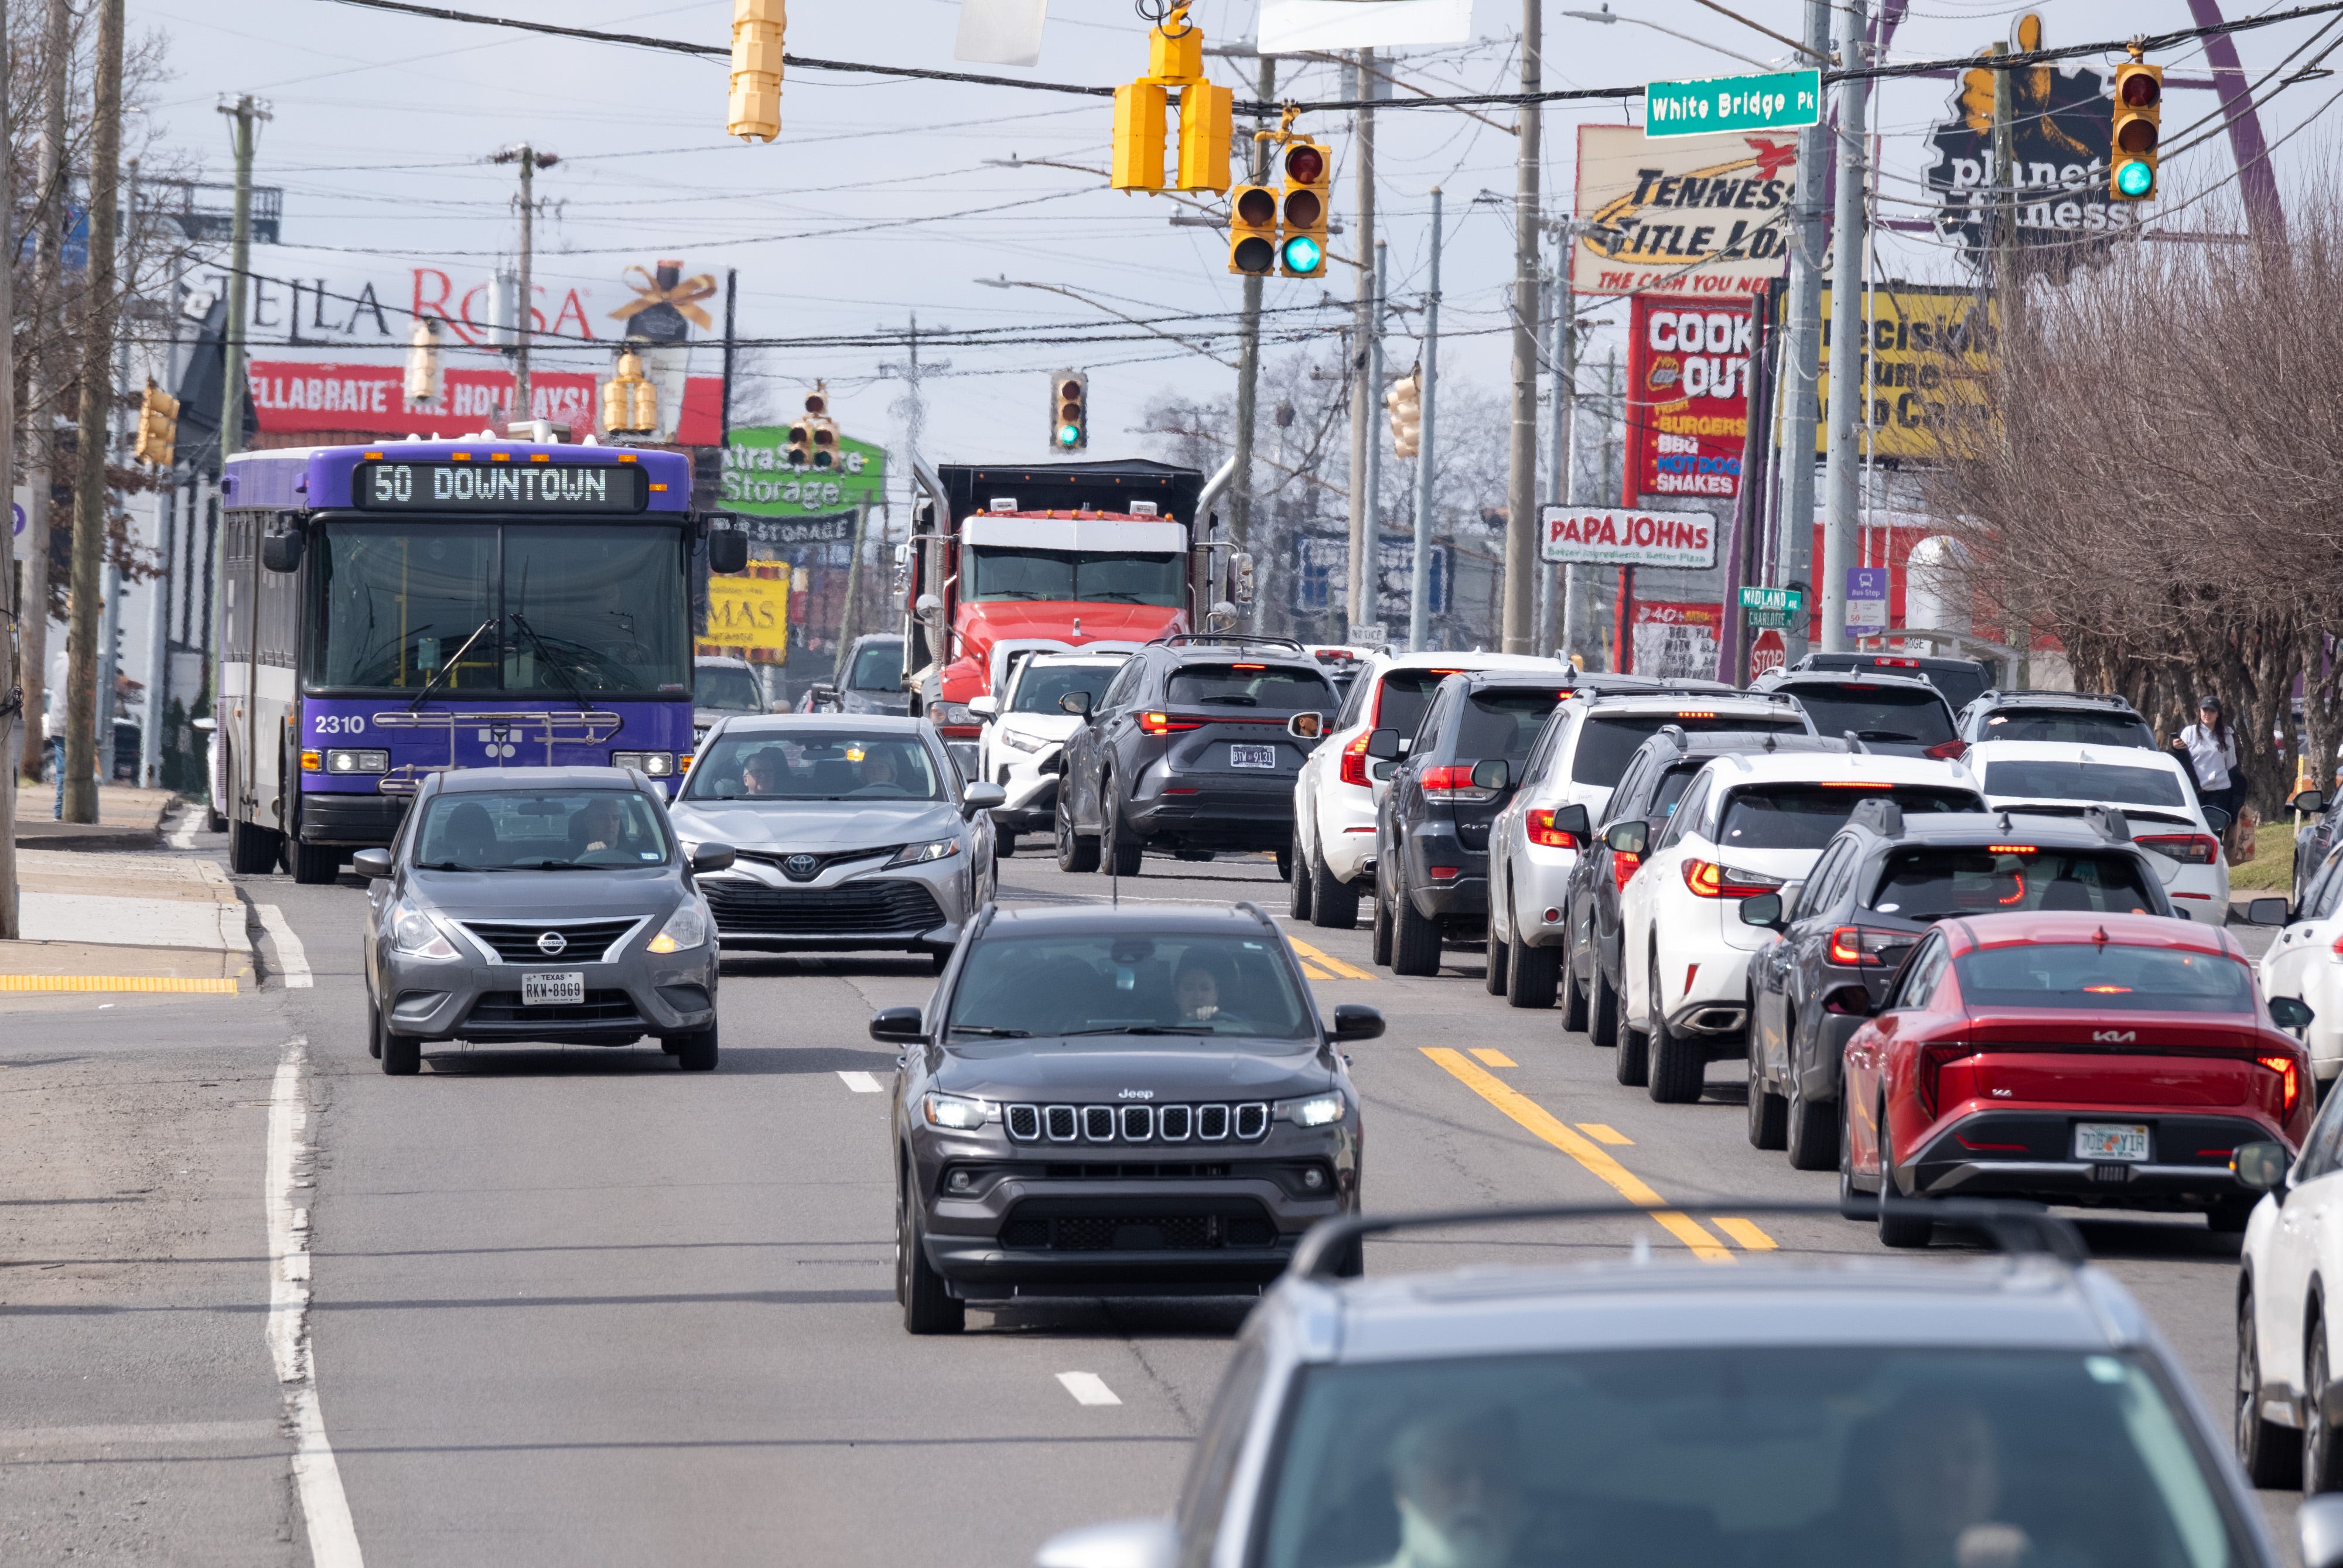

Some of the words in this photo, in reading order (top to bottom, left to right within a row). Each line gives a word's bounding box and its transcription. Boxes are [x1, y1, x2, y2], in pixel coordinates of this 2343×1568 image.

[1652, 97, 1709, 121] White
[1719, 91, 1785, 119] Bridge
[1798, 91, 1813, 110] Pk
[1631, 169, 1795, 209] TENNES
[1599, 272, 1634, 289] THE
[1694, 274, 1733, 292] YOU
[203, 274, 391, 346] TELLA
[1649, 311, 1753, 354] COOK
[250, 377, 387, 414] ELLABRATE
[453, 382, 589, 419] HOLIAYS!
[1658, 416, 1747, 437] BURGERS
[1658, 433, 1698, 454] BBQ
[1699, 456, 1742, 476] DOG
[375, 466, 412, 501] 50
[434, 467, 606, 501] DOWNTOWN
[722, 472, 840, 510] Storage
[1657, 473, 1733, 494] SHAKES
[1550, 514, 1617, 545] PAPA
[1621, 515, 1709, 549] JOHNS
[1743, 590, 1786, 607] MIDLAND
[1788, 600, 1797, 608] AVE
[1865, 589, 1880, 597] Stop
[1853, 602, 1858, 610] 3
[1749, 611, 1786, 626] CHARLOTTE
[1753, 649, 1784, 673] STOP
[315, 716, 365, 734] 2310
[1234, 751, 1246, 762] BTW
[1254, 752, 1272, 763] 9131
[527, 983, 547, 997] RKW
[553, 983, 580, 997] 8969
[1118, 1088, 1154, 1100] Jeep
